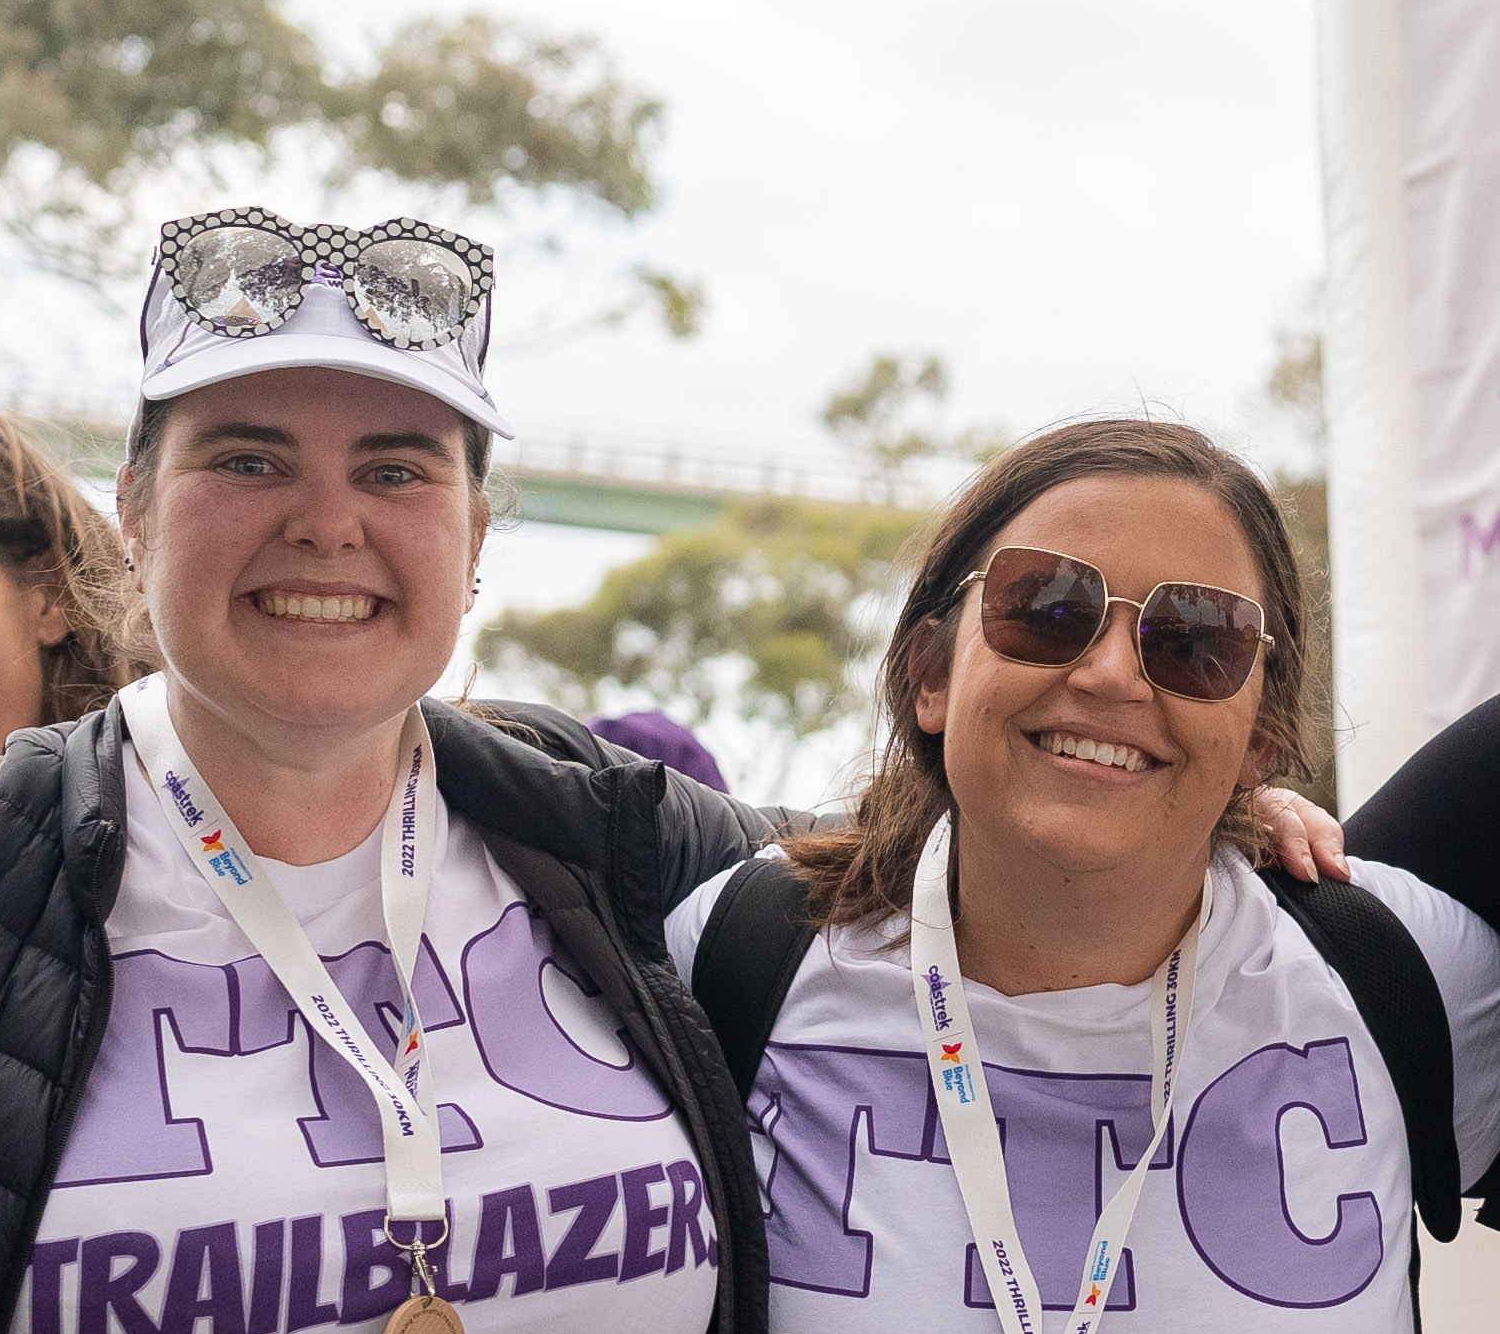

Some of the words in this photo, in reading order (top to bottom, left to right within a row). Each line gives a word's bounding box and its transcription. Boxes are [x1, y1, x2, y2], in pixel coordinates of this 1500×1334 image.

[165, 770, 205, 827] coastrek
[403, 777, 418, 842] THRILLING
[209, 857, 225, 877] Blue
[219, 851, 247, 885] Beyond
[402, 844, 415, 877] 2022
[1167, 949, 1181, 990] 30KM
[928, 964, 953, 1030] coastrek
[1165, 993, 1177, 1078] THRILLING
[311, 995, 339, 1027] 2022
[336, 1028, 391, 1091] THRILLING
[388, 1093, 414, 1136] 30KM
[941, 1068, 953, 1090] Blue
[954, 1066, 969, 1104] Beyond
[766, 1037, 1384, 1310] TTC
[992, 1240, 1013, 1276] 2022
[1093, 1241, 1108, 1280] Beyond
[1100, 1258, 1110, 1280] Blue
